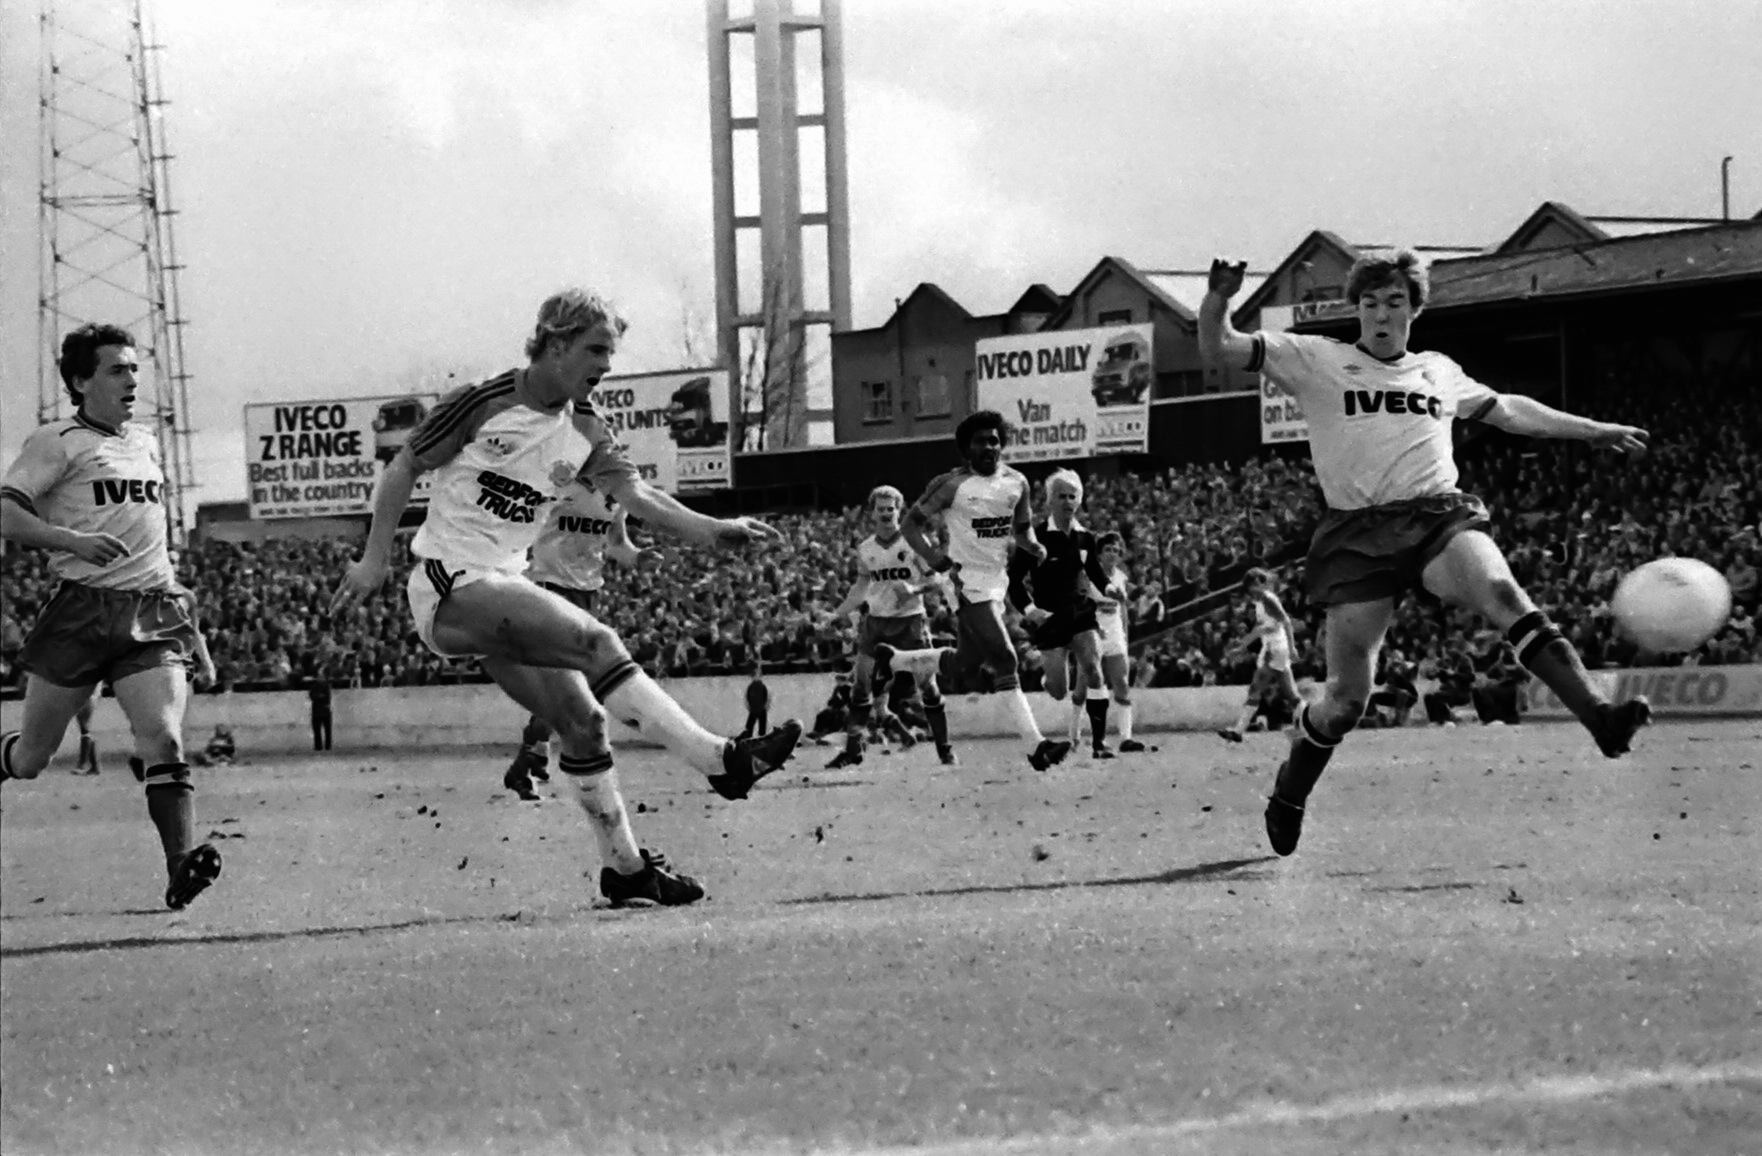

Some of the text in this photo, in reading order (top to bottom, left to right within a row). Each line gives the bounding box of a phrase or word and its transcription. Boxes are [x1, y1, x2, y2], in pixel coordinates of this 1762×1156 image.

[978, 343, 1092, 380] IVECO DAILY
[275, 405, 347, 432] IVECO
[1017, 398, 1050, 423] Van
[260, 430, 362, 461] Z RANGE
[1004, 422, 1030, 447] he
[1034, 418, 1086, 446] match
[250, 463, 288, 482] Best
[324, 458, 375, 479] backs
[93, 479, 164, 506] IVEC
[272, 483, 300, 502] the
[304, 481, 375, 501] country
[1613, 672, 1728, 706] IVECO
